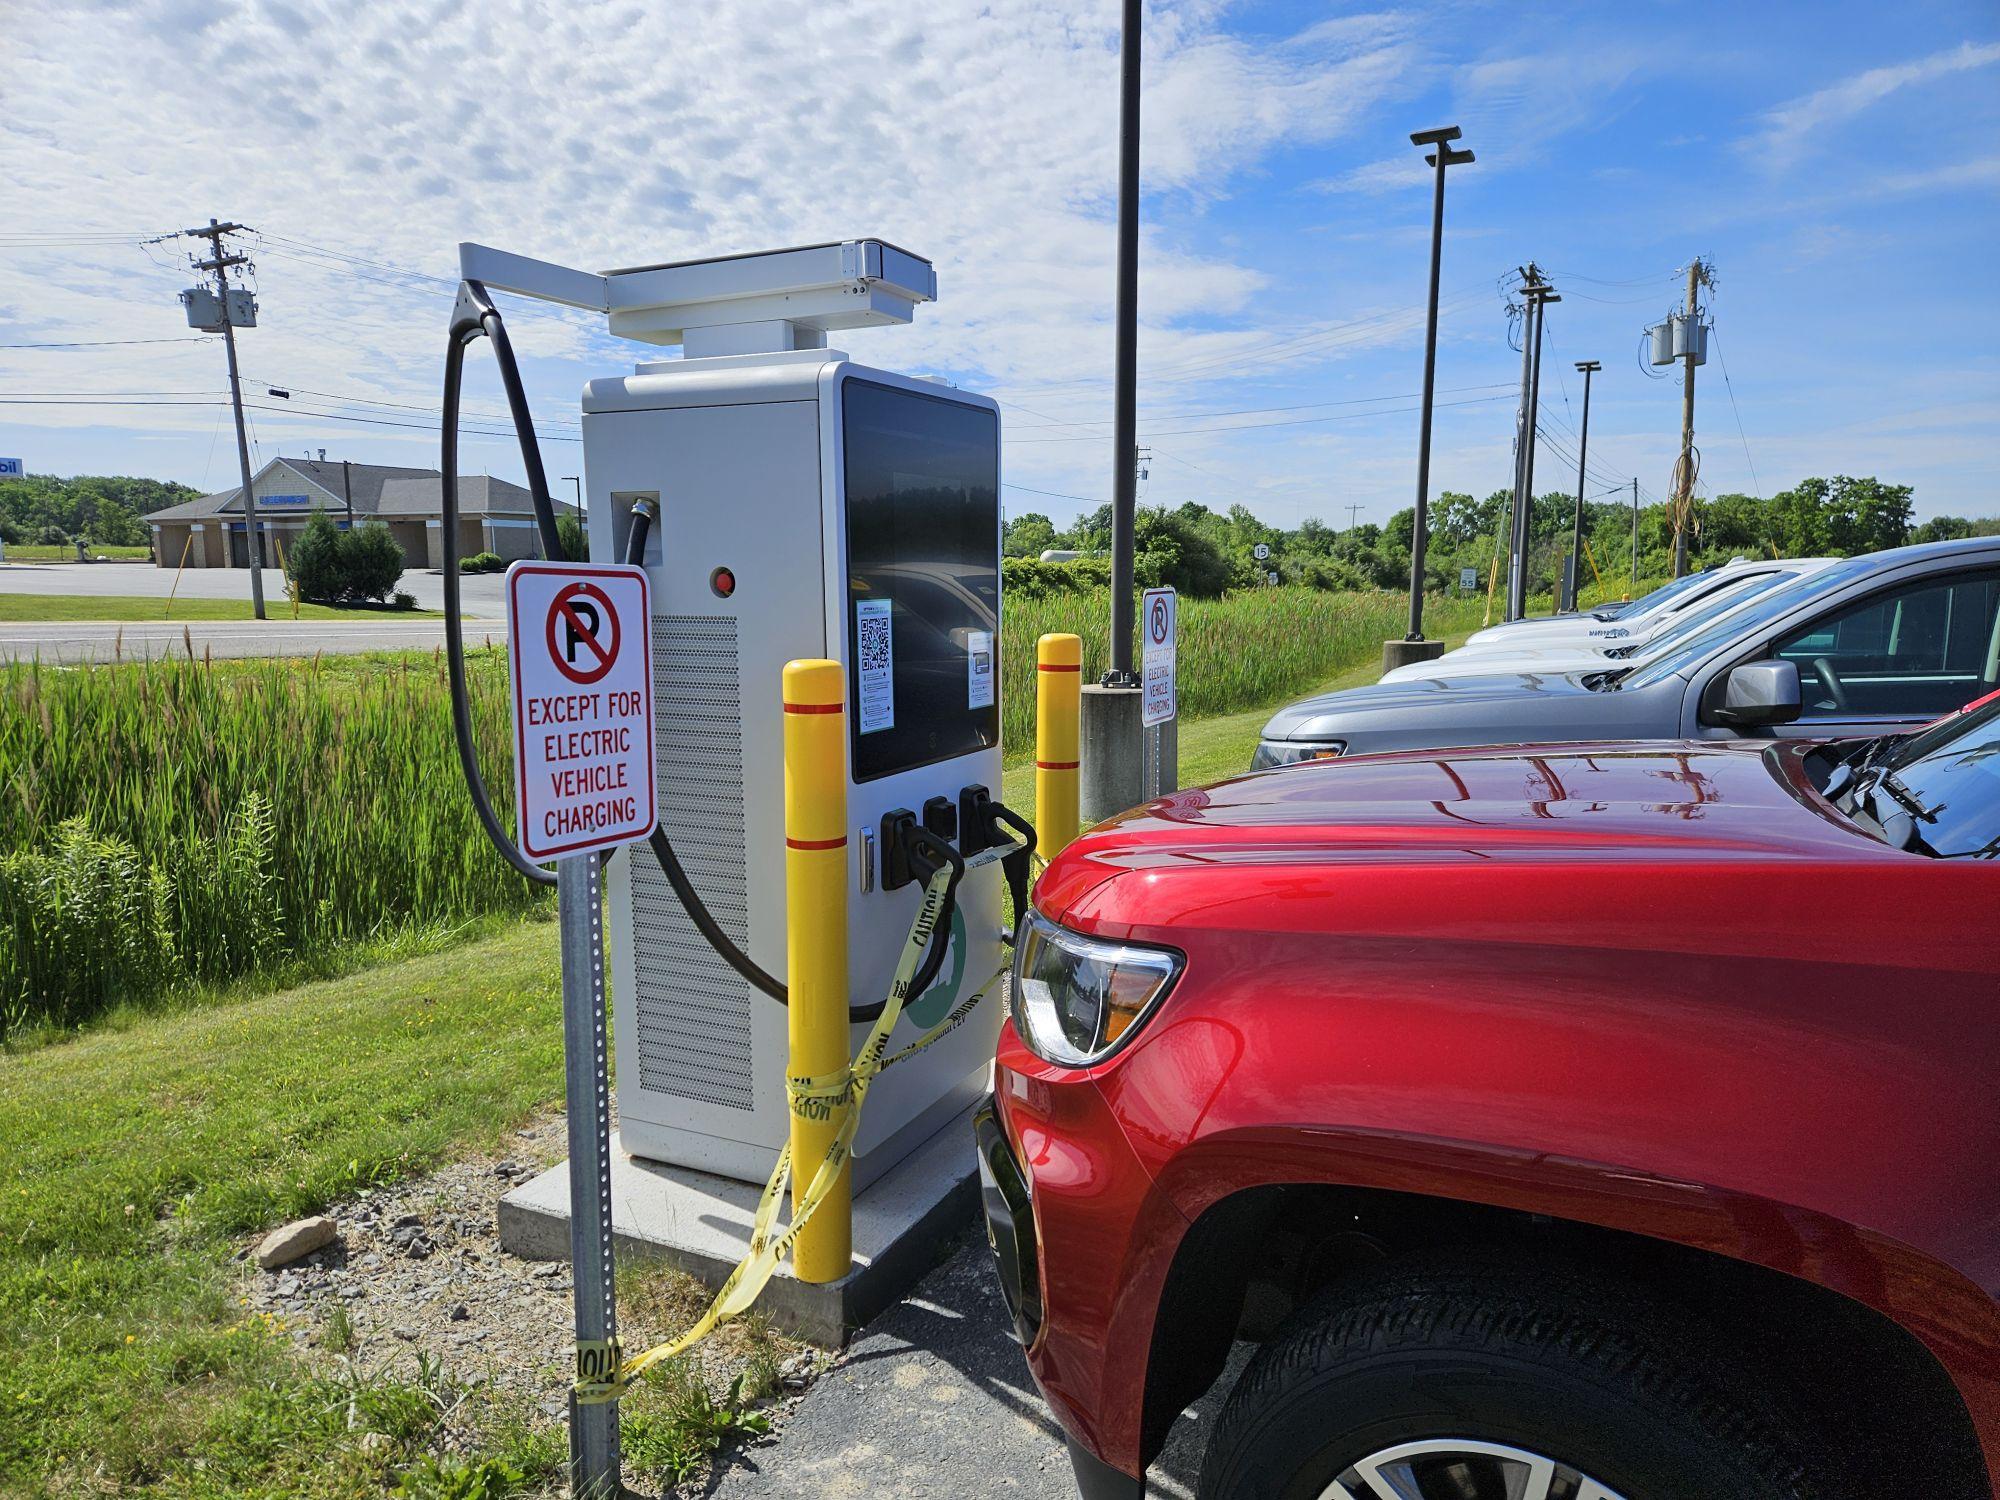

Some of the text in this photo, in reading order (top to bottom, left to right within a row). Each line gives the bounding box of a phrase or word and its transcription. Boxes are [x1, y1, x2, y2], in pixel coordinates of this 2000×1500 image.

[1257, 547, 1267, 557] 15
[1148, 665, 1170, 681] ELECTRIC
[1149, 682, 1168, 698] VEHICLE
[528, 691, 642, 725] EXCEPT FOR
[1147, 698, 1170, 716] CHARGING
[544, 728, 631, 762] ELECTRIC
[551, 763, 628, 798] VEHICLE
[544, 797, 636, 837] CHARGING
[912, 889, 938, 948] CAUTION
